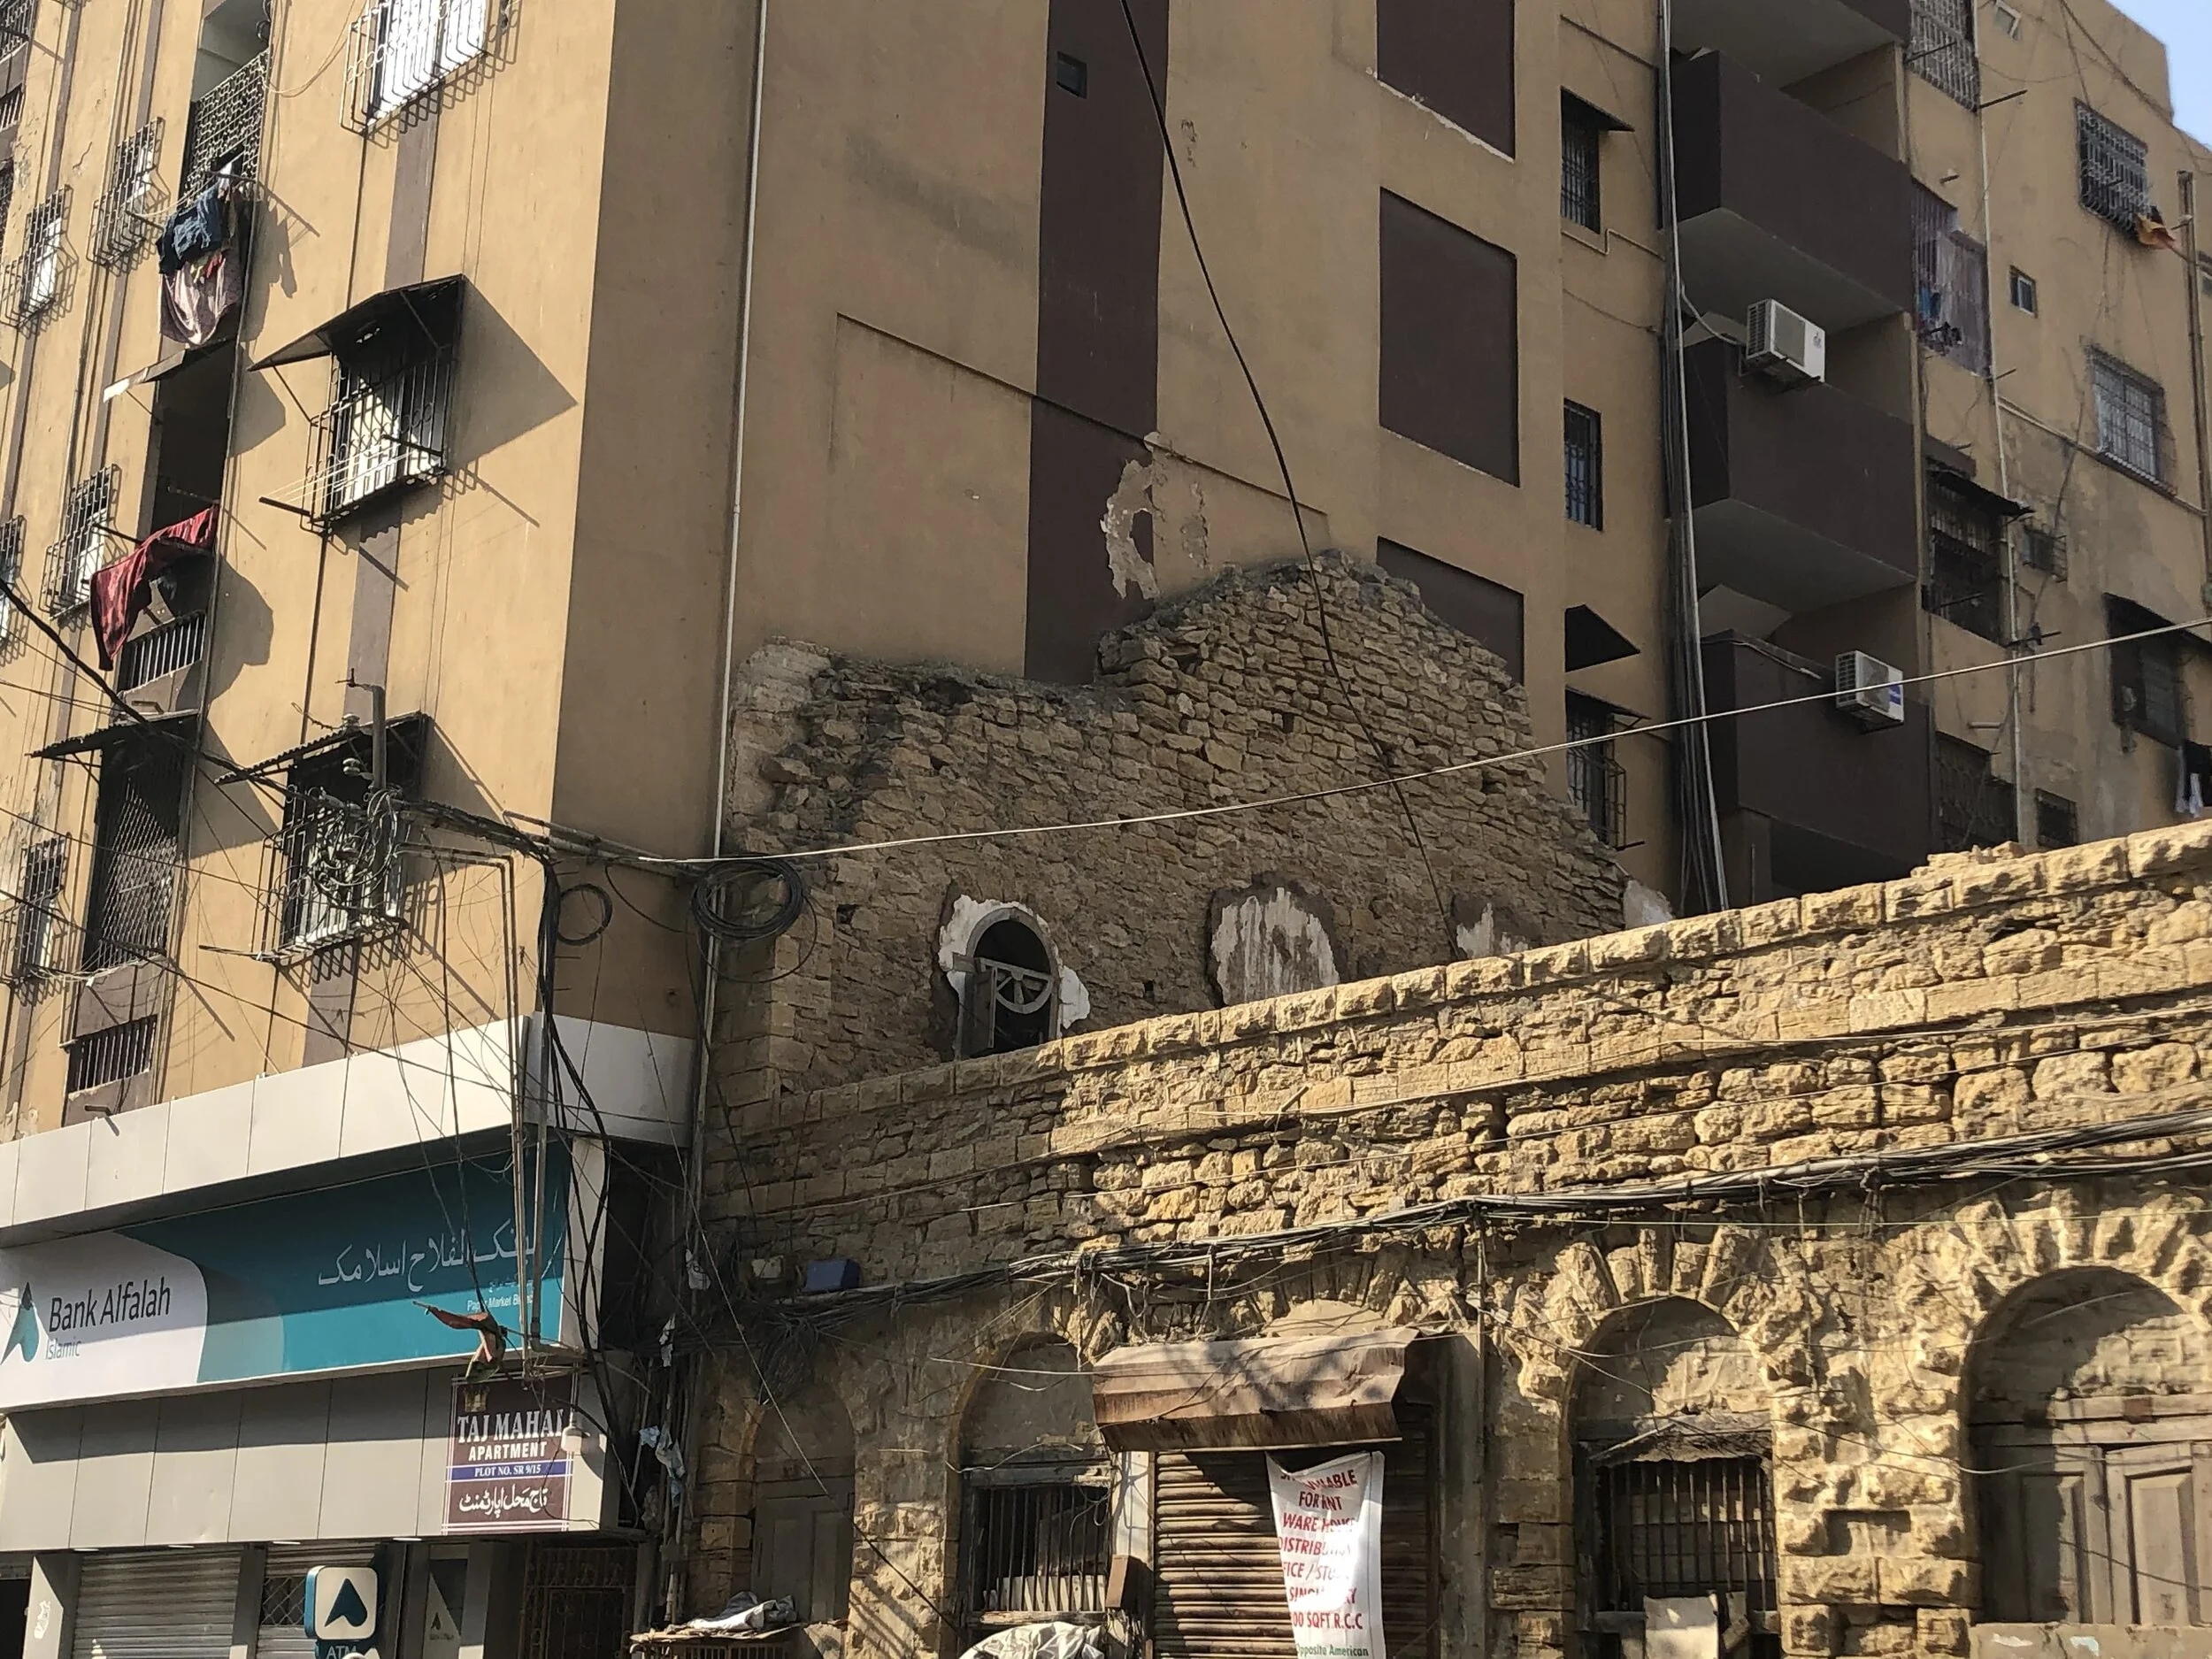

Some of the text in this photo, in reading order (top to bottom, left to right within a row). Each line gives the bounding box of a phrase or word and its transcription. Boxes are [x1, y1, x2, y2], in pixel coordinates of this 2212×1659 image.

[318, 1239, 406, 1286] اسلامک
[49, 1276, 171, 1333] Bank Alfalah
[466, 1299, 488, 1312] Papr
[488, 1296, 511, 1308] Market
[45, 1336, 81, 1361] Islamic
[457, 1414, 490, 1444] TAJ
[468, 1441, 548, 1462] APARTMENT
[474, 1464, 541, 1478] PLOT NO. SR 9/15
[458, 1486, 504, 1519] اپارٹمنٹ
[529, 1486, 549, 1514] تاج
[1298, 1491, 1320, 1509] FOR
[1283, 1512, 1319, 1532] WARE
[1307, 1611, 1331, 1629] SQFT
[1329, 1643, 1370, 1657] American
